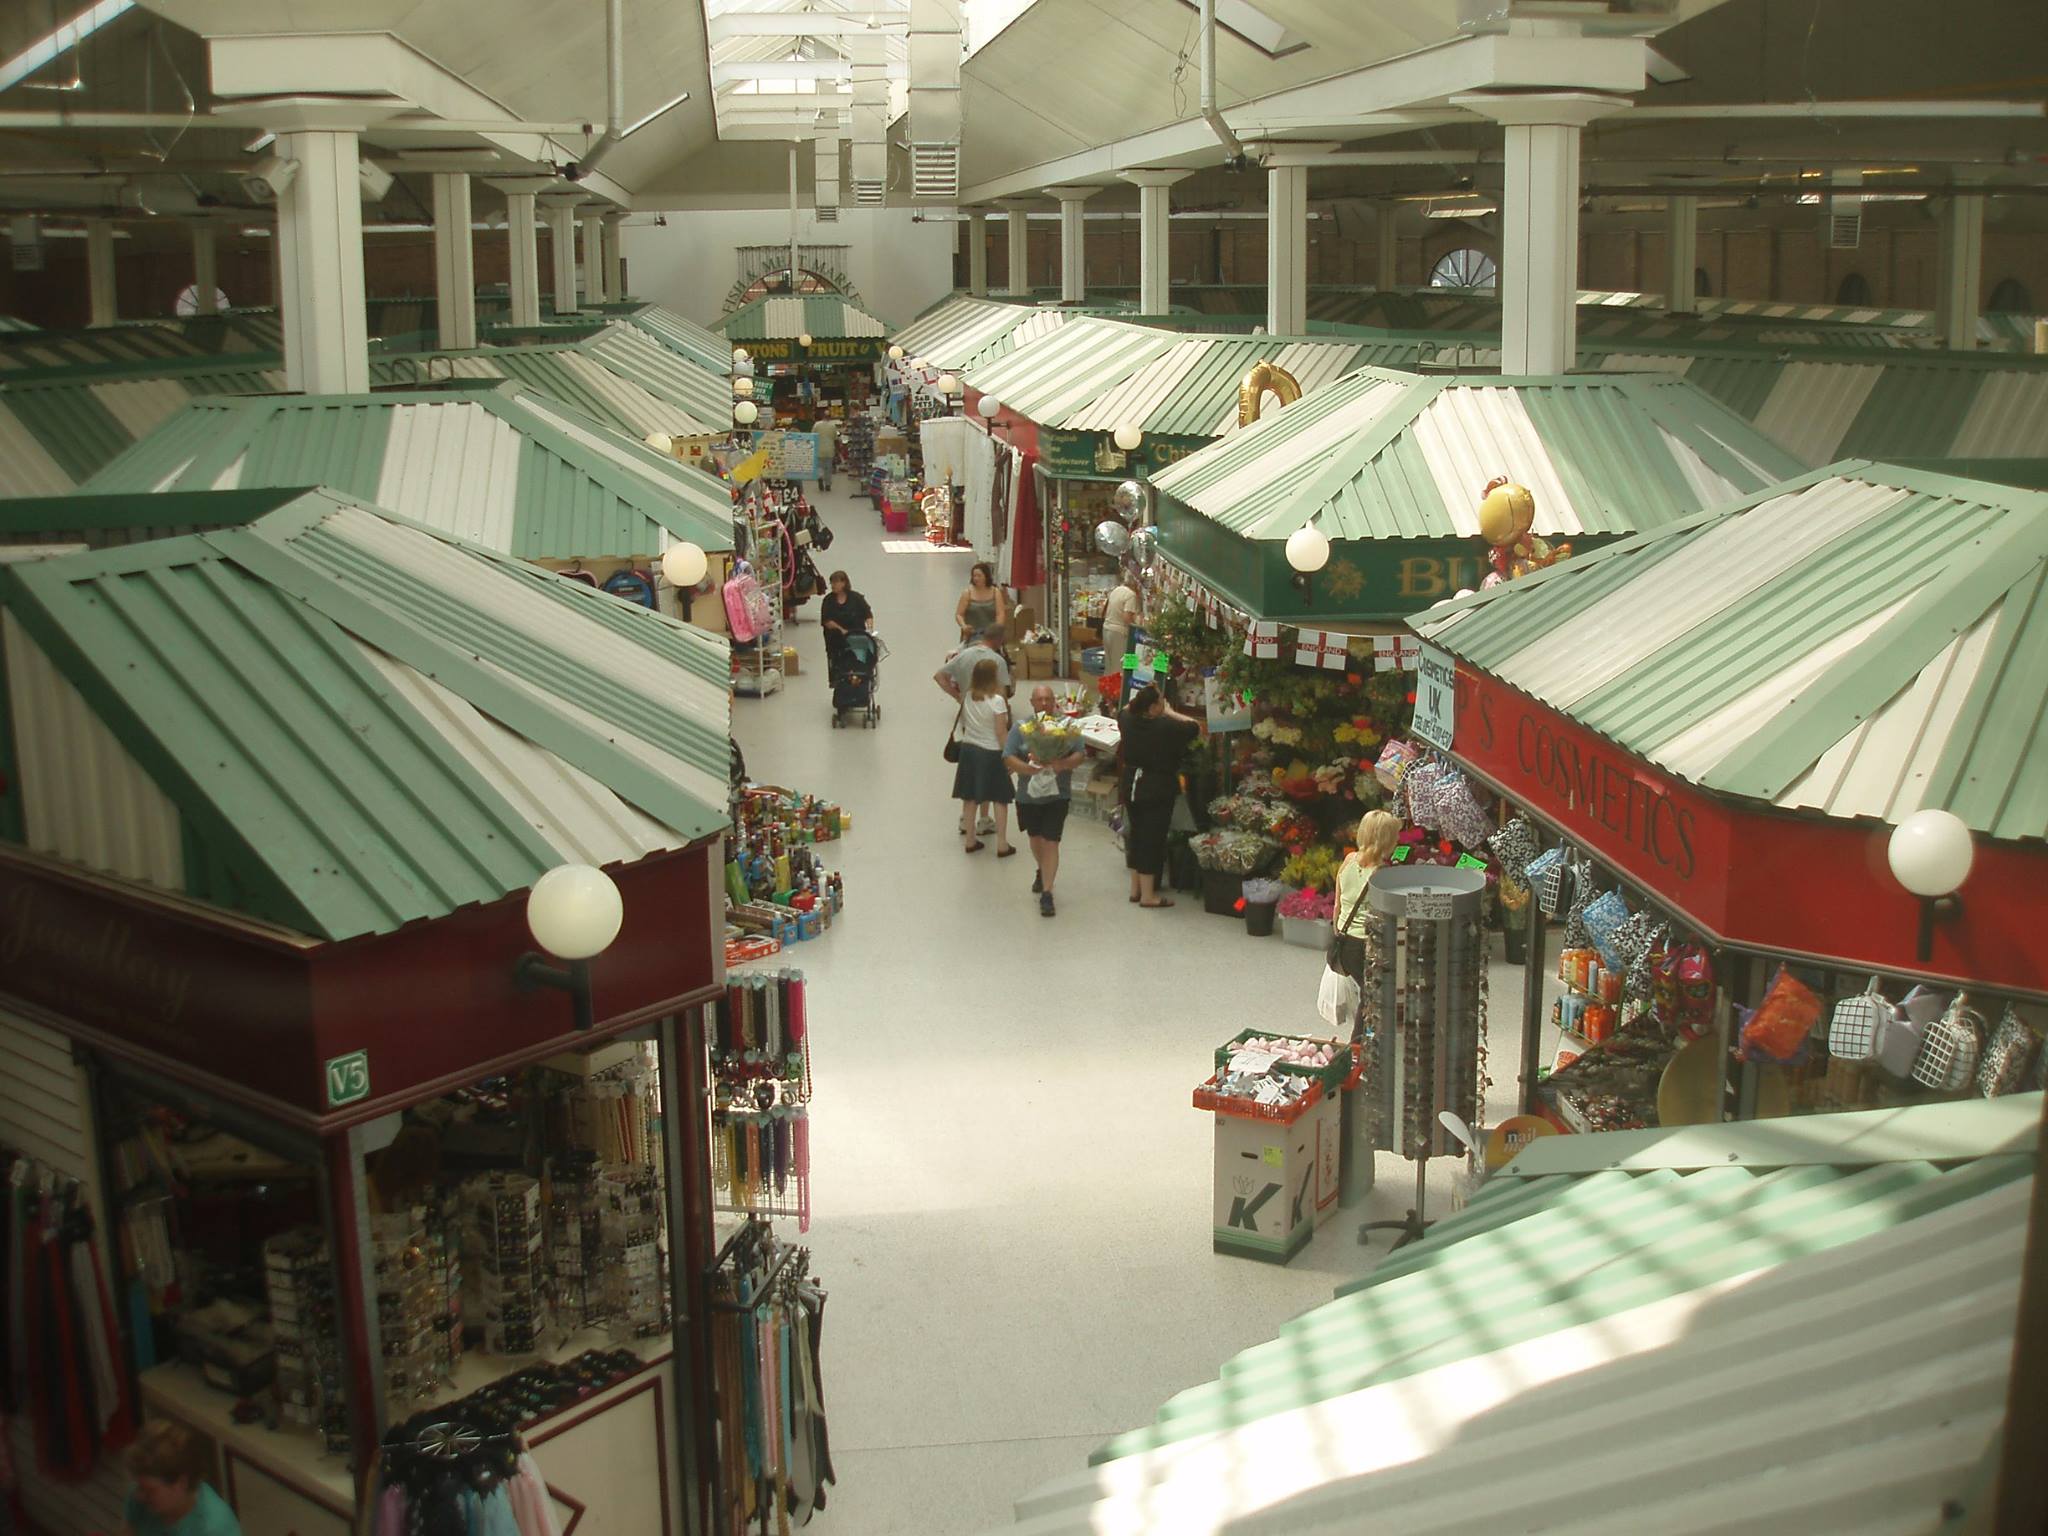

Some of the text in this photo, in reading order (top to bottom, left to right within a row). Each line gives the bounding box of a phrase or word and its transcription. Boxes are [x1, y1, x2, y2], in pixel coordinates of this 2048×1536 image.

[722, 279, 747, 314] FISH
[762, 255, 807, 271] MET
[807, 341, 856, 357] FRUIT
[913, 401, 933, 409] PETS
[783, 487, 799, 503] £4
[1301, 643, 1342, 655] ENGLAND
[1378, 650, 1418, 658] ENGLAND
[1428, 685, 1442, 720] UK
[1517, 714, 1696, 880] COSMETICS
[331, 1060, 366, 1095] V5
[1227, 1182, 1283, 1232] K
